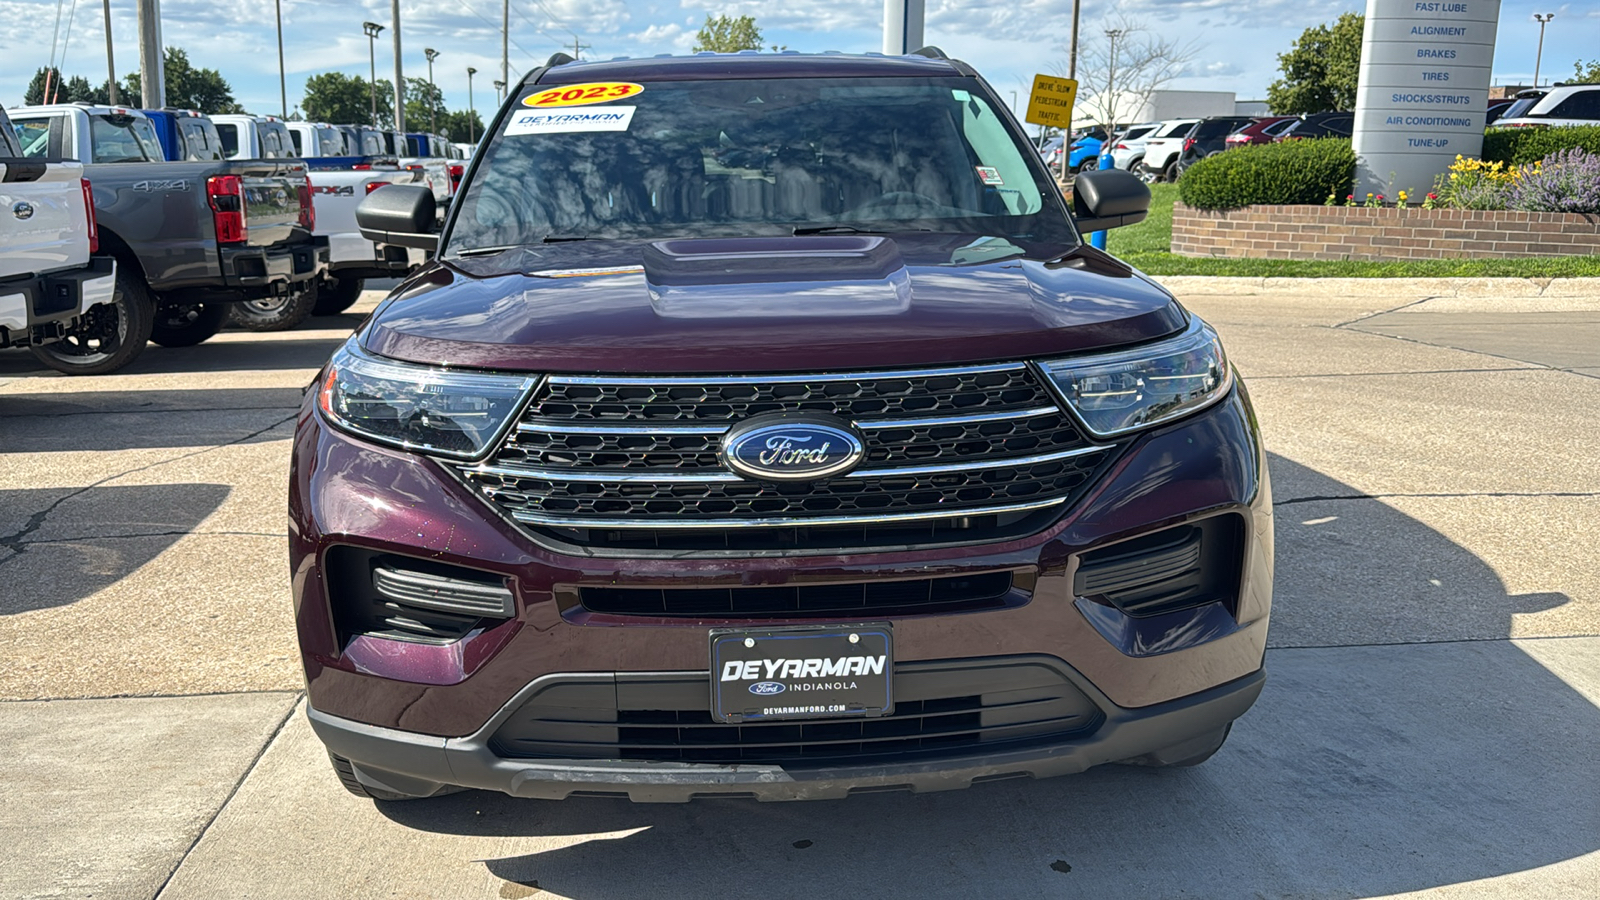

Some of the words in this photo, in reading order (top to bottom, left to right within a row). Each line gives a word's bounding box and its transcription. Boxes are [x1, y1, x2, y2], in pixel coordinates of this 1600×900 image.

[1415, 2, 1440, 12] FAST
[1442, 3, 1467, 13] LUBE
[1410, 26, 1467, 37] ALIGNMENT
[1416, 48, 1456, 59] BRAKES
[1422, 72, 1449, 81] TIRES
[1037, 82, 1054, 92] DRIVE
[1056, 84, 1071, 94] SLOW
[535, 85, 632, 105] 2023
[1392, 93, 1470, 105] SHOCKS/STRUTS
[1034, 96, 1068, 108] PEDESTRIAN
[518, 113, 626, 124] DEYARMAN
[1038, 111, 1061, 121] TRAFFIC
[1386, 116, 1403, 125] AIR
[1405, 116, 1471, 127] CONDITIONING
[1407, 138, 1449, 148] TUNE-UP
[759, 435, 831, 465] Ford
[721, 655, 886, 682] DEYARMAN
[755, 683, 779, 694] Ford
[789, 681, 858, 692] INDIANOLA
[763, 705, 846, 715] DEYARMANFORD.COM
